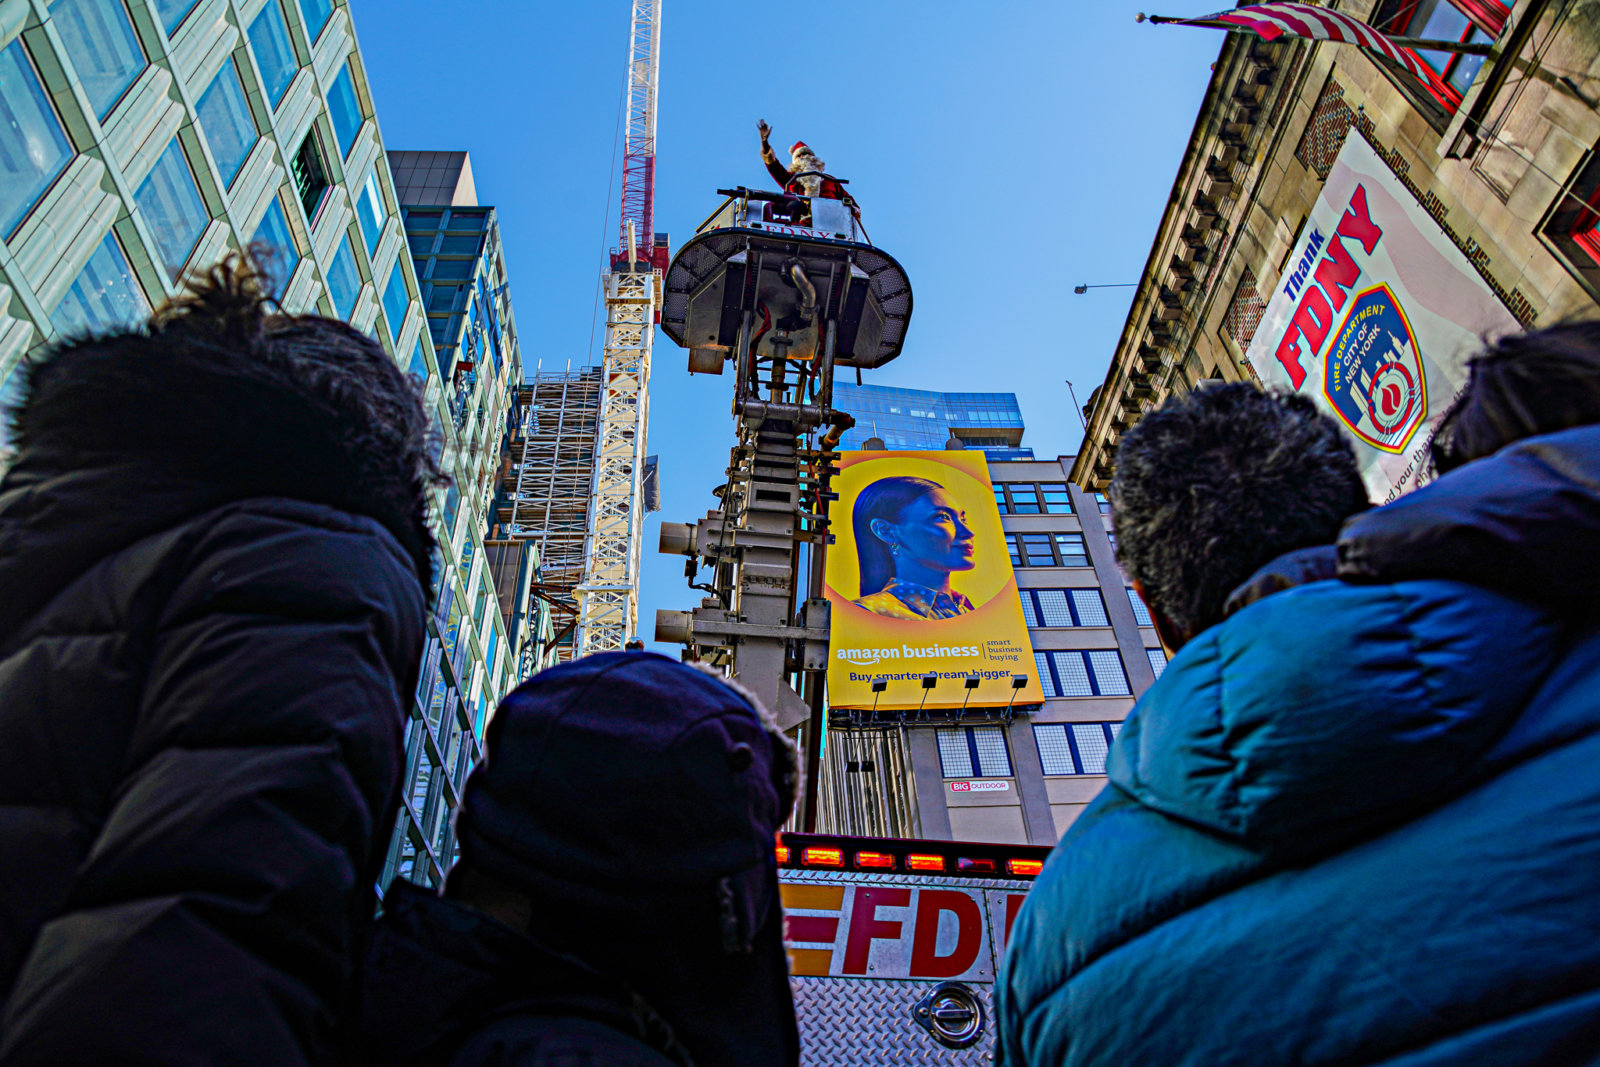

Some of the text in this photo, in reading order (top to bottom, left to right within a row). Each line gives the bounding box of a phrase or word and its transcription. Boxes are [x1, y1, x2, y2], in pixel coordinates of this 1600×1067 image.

[764, 224, 831, 238] FDNY
[1283, 228, 1325, 302] Thank
[1275, 183, 1383, 392] FDNY
[1336, 304, 1386, 359] DEPARTMENT
[1343, 322, 1368, 366] CITY OF
[1345, 323, 1381, 384] NEW YORK
[1395, 462, 1415, 494] your
[836, 643, 980, 660] amazon business
[987, 646, 1023, 654] business
[989, 653, 1019, 662] buying
[849, 672, 872, 683] Buy
[842, 886, 1028, 978] FD
